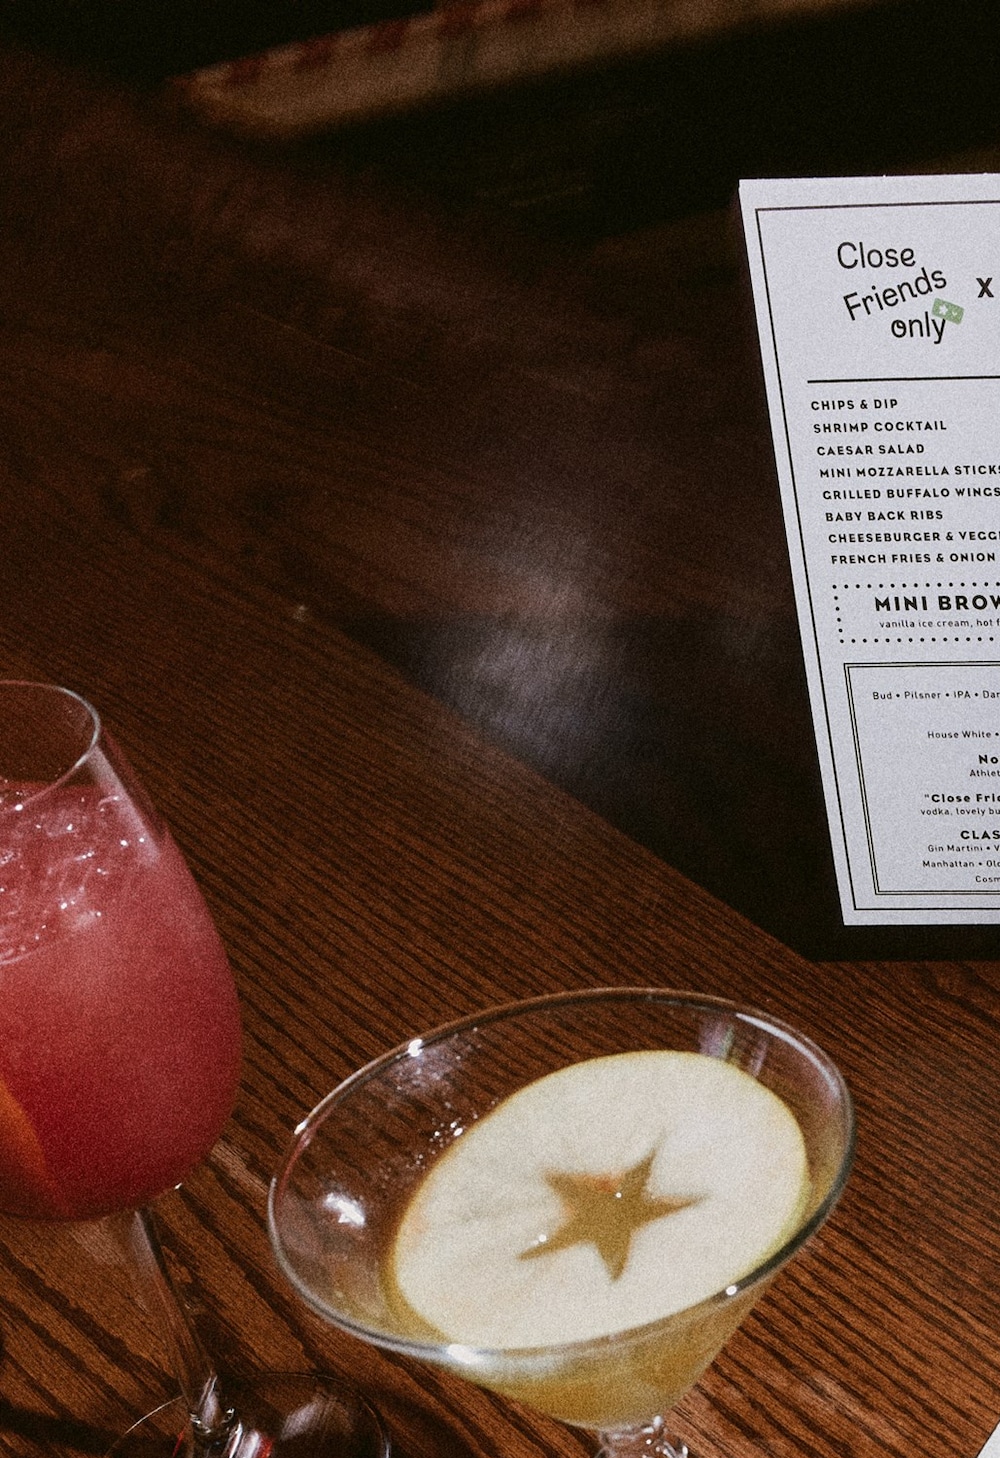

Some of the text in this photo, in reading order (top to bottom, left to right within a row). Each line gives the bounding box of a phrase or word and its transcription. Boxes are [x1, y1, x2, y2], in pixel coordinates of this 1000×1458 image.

[837, 242, 917, 270] Close
[842, 267, 948, 322] Friends
[842, 267, 948, 322] Friends
[891, 311, 947, 345] only
[810, 398, 898, 412] CHIPS & DIP
[813, 420, 947, 434] SHRIMP COCKTAIL
[816, 443, 925, 457] CAESAR SALAD
[819, 467, 851, 478] MINI
[855, 465, 950, 478] MOZZARELLA
[822, 488, 882, 501] GRILLED
[886, 487, 951, 499] BUFFALO
[824, 509, 944, 522] BABY BACK RIBS
[827, 531, 941, 544] CHEESEBURGER
[945, 531, 954, 542] &
[830, 554, 887, 565] FRENCH
[891, 553, 932, 564] FRIES
[935, 552, 944, 563] &
[949, 552, 996, 563] ONION
[874, 595, 928, 612] MINI
[879, 619, 916, 629] vanilla
[917, 620, 934, 628] ice
[975, 618, 993, 627] hot
[871, 690, 893, 701] Bud
[903, 690, 941, 700] Pilsner
[953, 690, 971, 699] IPA
[927, 731, 960, 739] House
[961, 730, 992, 739] White
[955, 807, 986, 817] lovely
[927, 843, 945, 853] Gin
[946, 844, 984, 853] Martini
[922, 860, 975, 869] Manhattan
